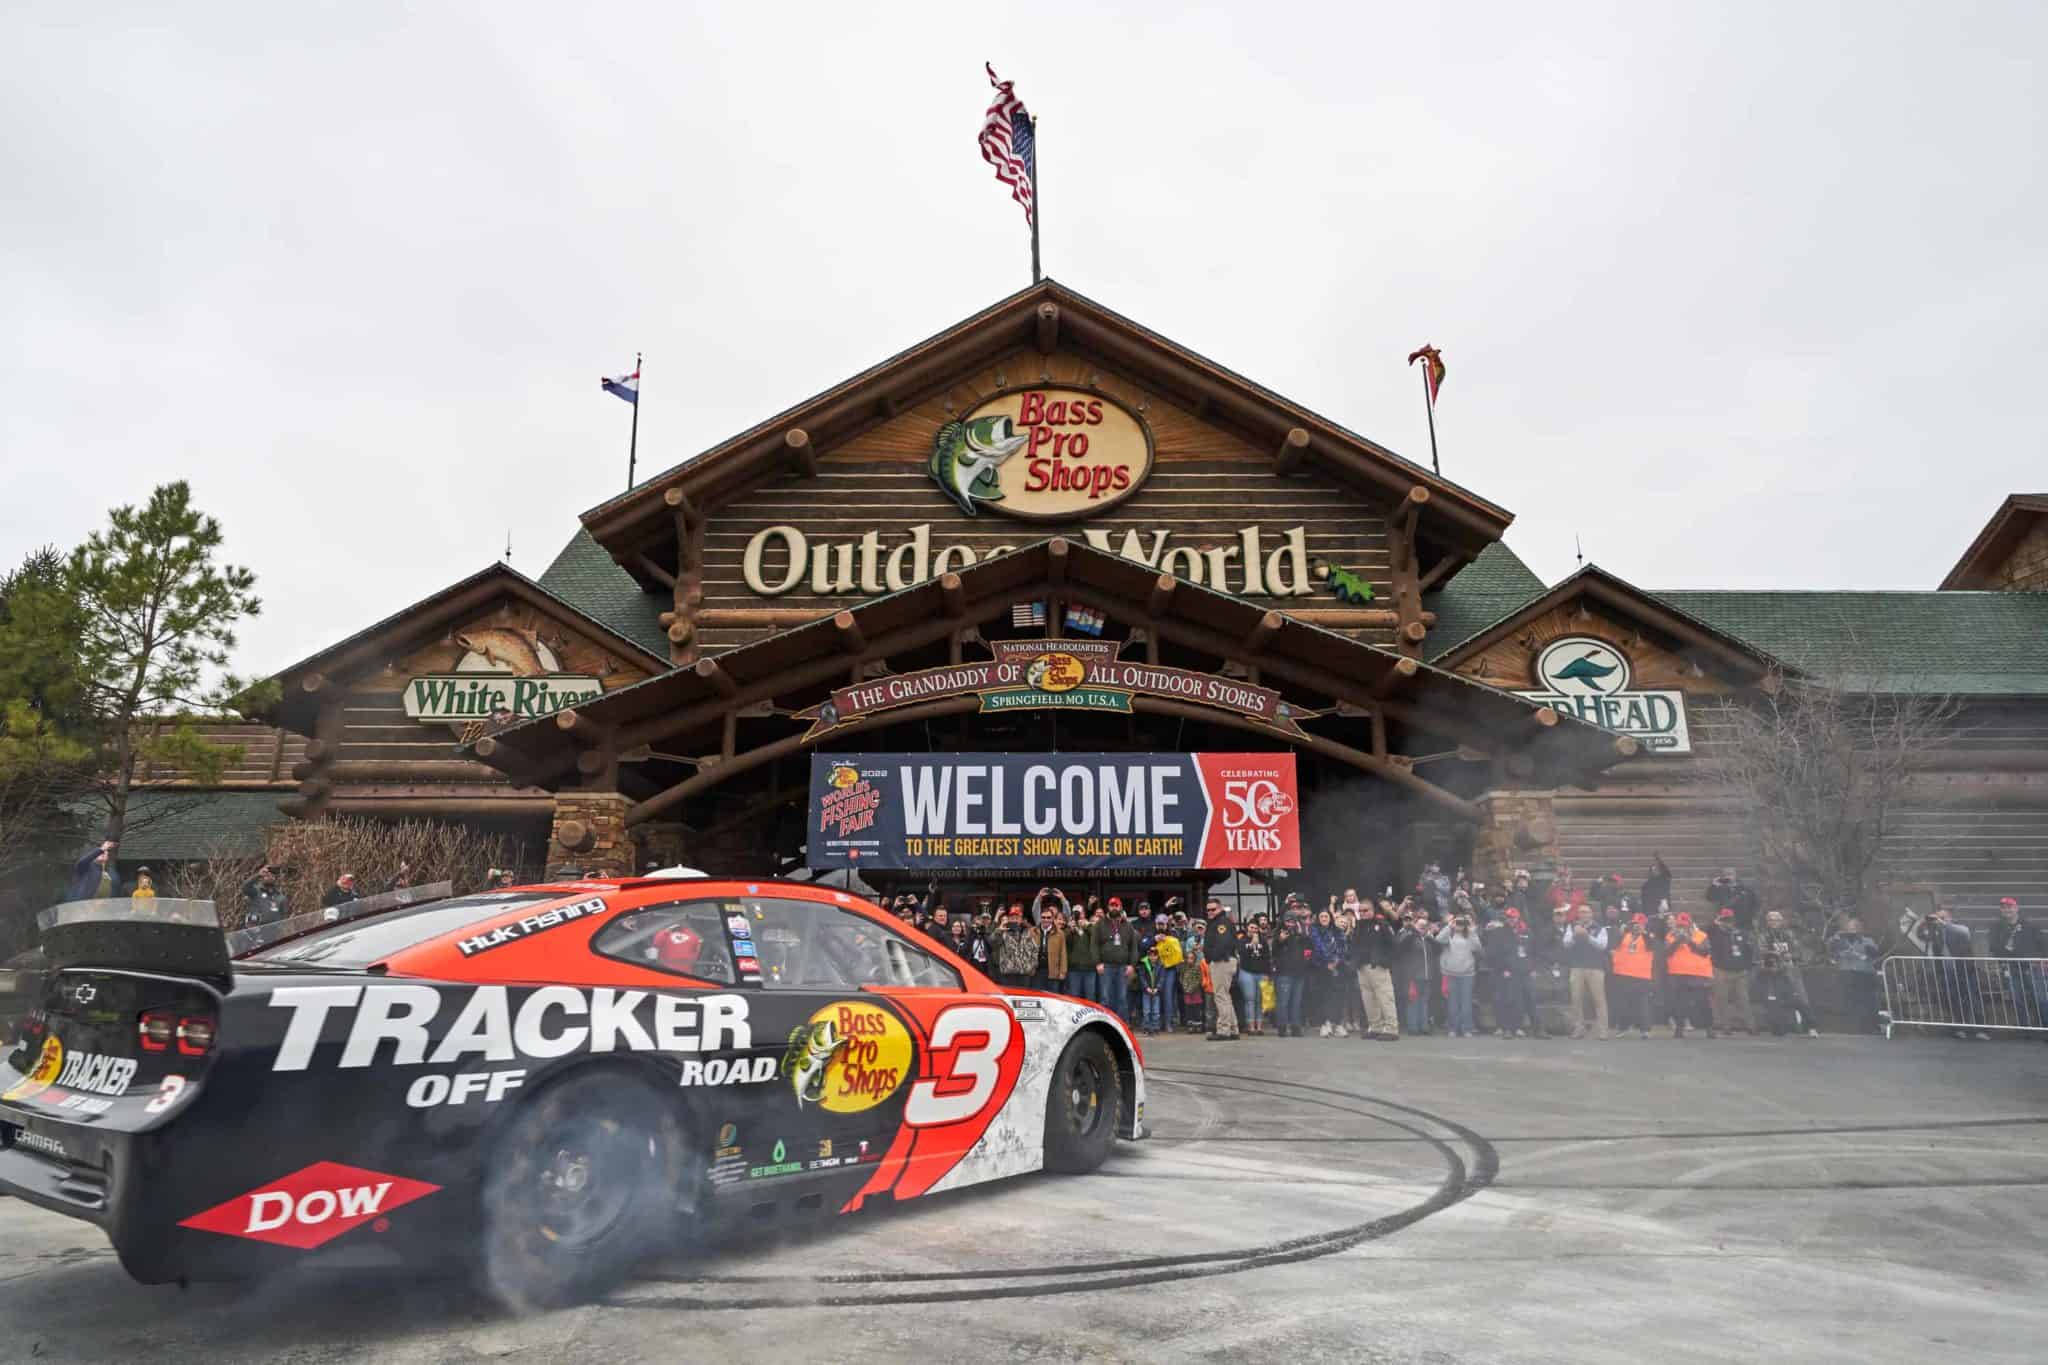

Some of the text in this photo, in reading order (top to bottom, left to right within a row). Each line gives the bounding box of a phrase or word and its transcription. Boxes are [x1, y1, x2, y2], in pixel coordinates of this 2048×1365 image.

[1016, 391, 1103, 426] Bass
[1024, 425, 1089, 458] Pro
[1024, 458, 1130, 499] Shops
[1003, 643, 1109, 653] NATIONAL HEADQUARTERS
[414, 679, 506, 715] White
[848, 663, 1266, 712] THE GRANDADDY OF ALL OUTDOOR STORES
[1066, 694, 1084, 705] MO
[1220, 769, 1280, 778] CELEBRATING
[900, 765, 1184, 835] WELCOME
[1223, 780, 1283, 828] 50
[905, 838, 1184, 856] TO THE GREATEST SHOW & SALE ON EARTH!
[1225, 829, 1282, 851] YEARS
[457, 897, 607, 955] Huk Fishing
[269, 985, 752, 1072] TRACKER
[838, 1006, 886, 1035] Bass
[840, 1035, 878, 1064] Pro
[904, 1003, 1013, 1128] 3
[55, 1050, 139, 1096] TRACKER
[406, 1059, 775, 1108] OFF ROAD
[838, 1063, 898, 1100] Shops
[143, 1074, 187, 1113] 3
[243, 1182, 394, 1234] DOW
